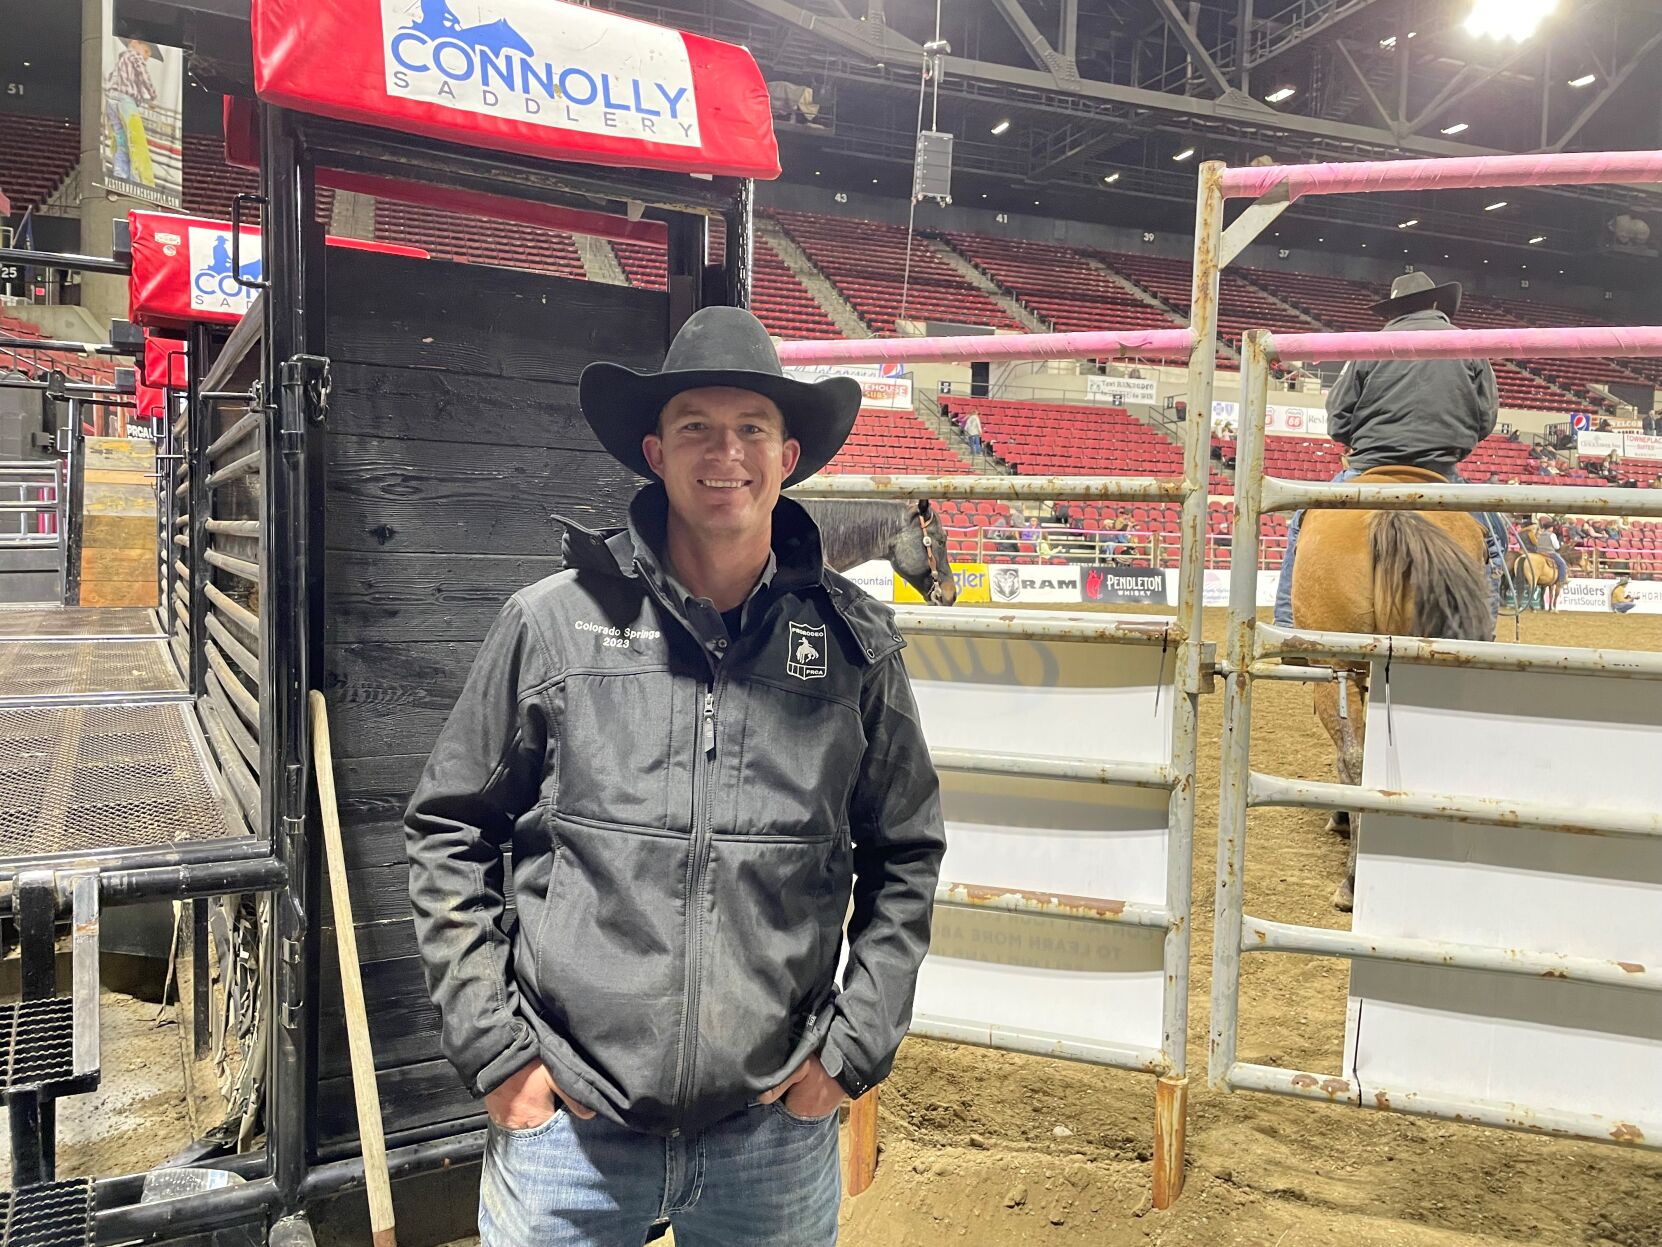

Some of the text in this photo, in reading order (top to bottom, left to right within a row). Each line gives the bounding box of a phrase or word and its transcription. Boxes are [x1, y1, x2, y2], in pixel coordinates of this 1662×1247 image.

[391, 32, 688, 119] CONNOLLY
[8, 83, 24, 95] 51
[393, 71, 693, 138] SADDLERY
[834, 193, 848, 203] 43
[995, 213, 1008, 224] 41
[1143, 232, 1155, 242] 39
[1278, 249, 1290, 258] 37
[1, 267, 17, 279] 25
[1288, 416, 1301, 426] 66
[1626, 434, 1662, 444] TOWNEPLAC
[1020, 579, 1077, 590] RAM
[1106, 574, 1162, 592] PENDLETON
[1563, 596, 1606, 606] FirstSource
[574, 620, 661, 640] Colorado Springs
[602, 637, 630, 649] 2023
